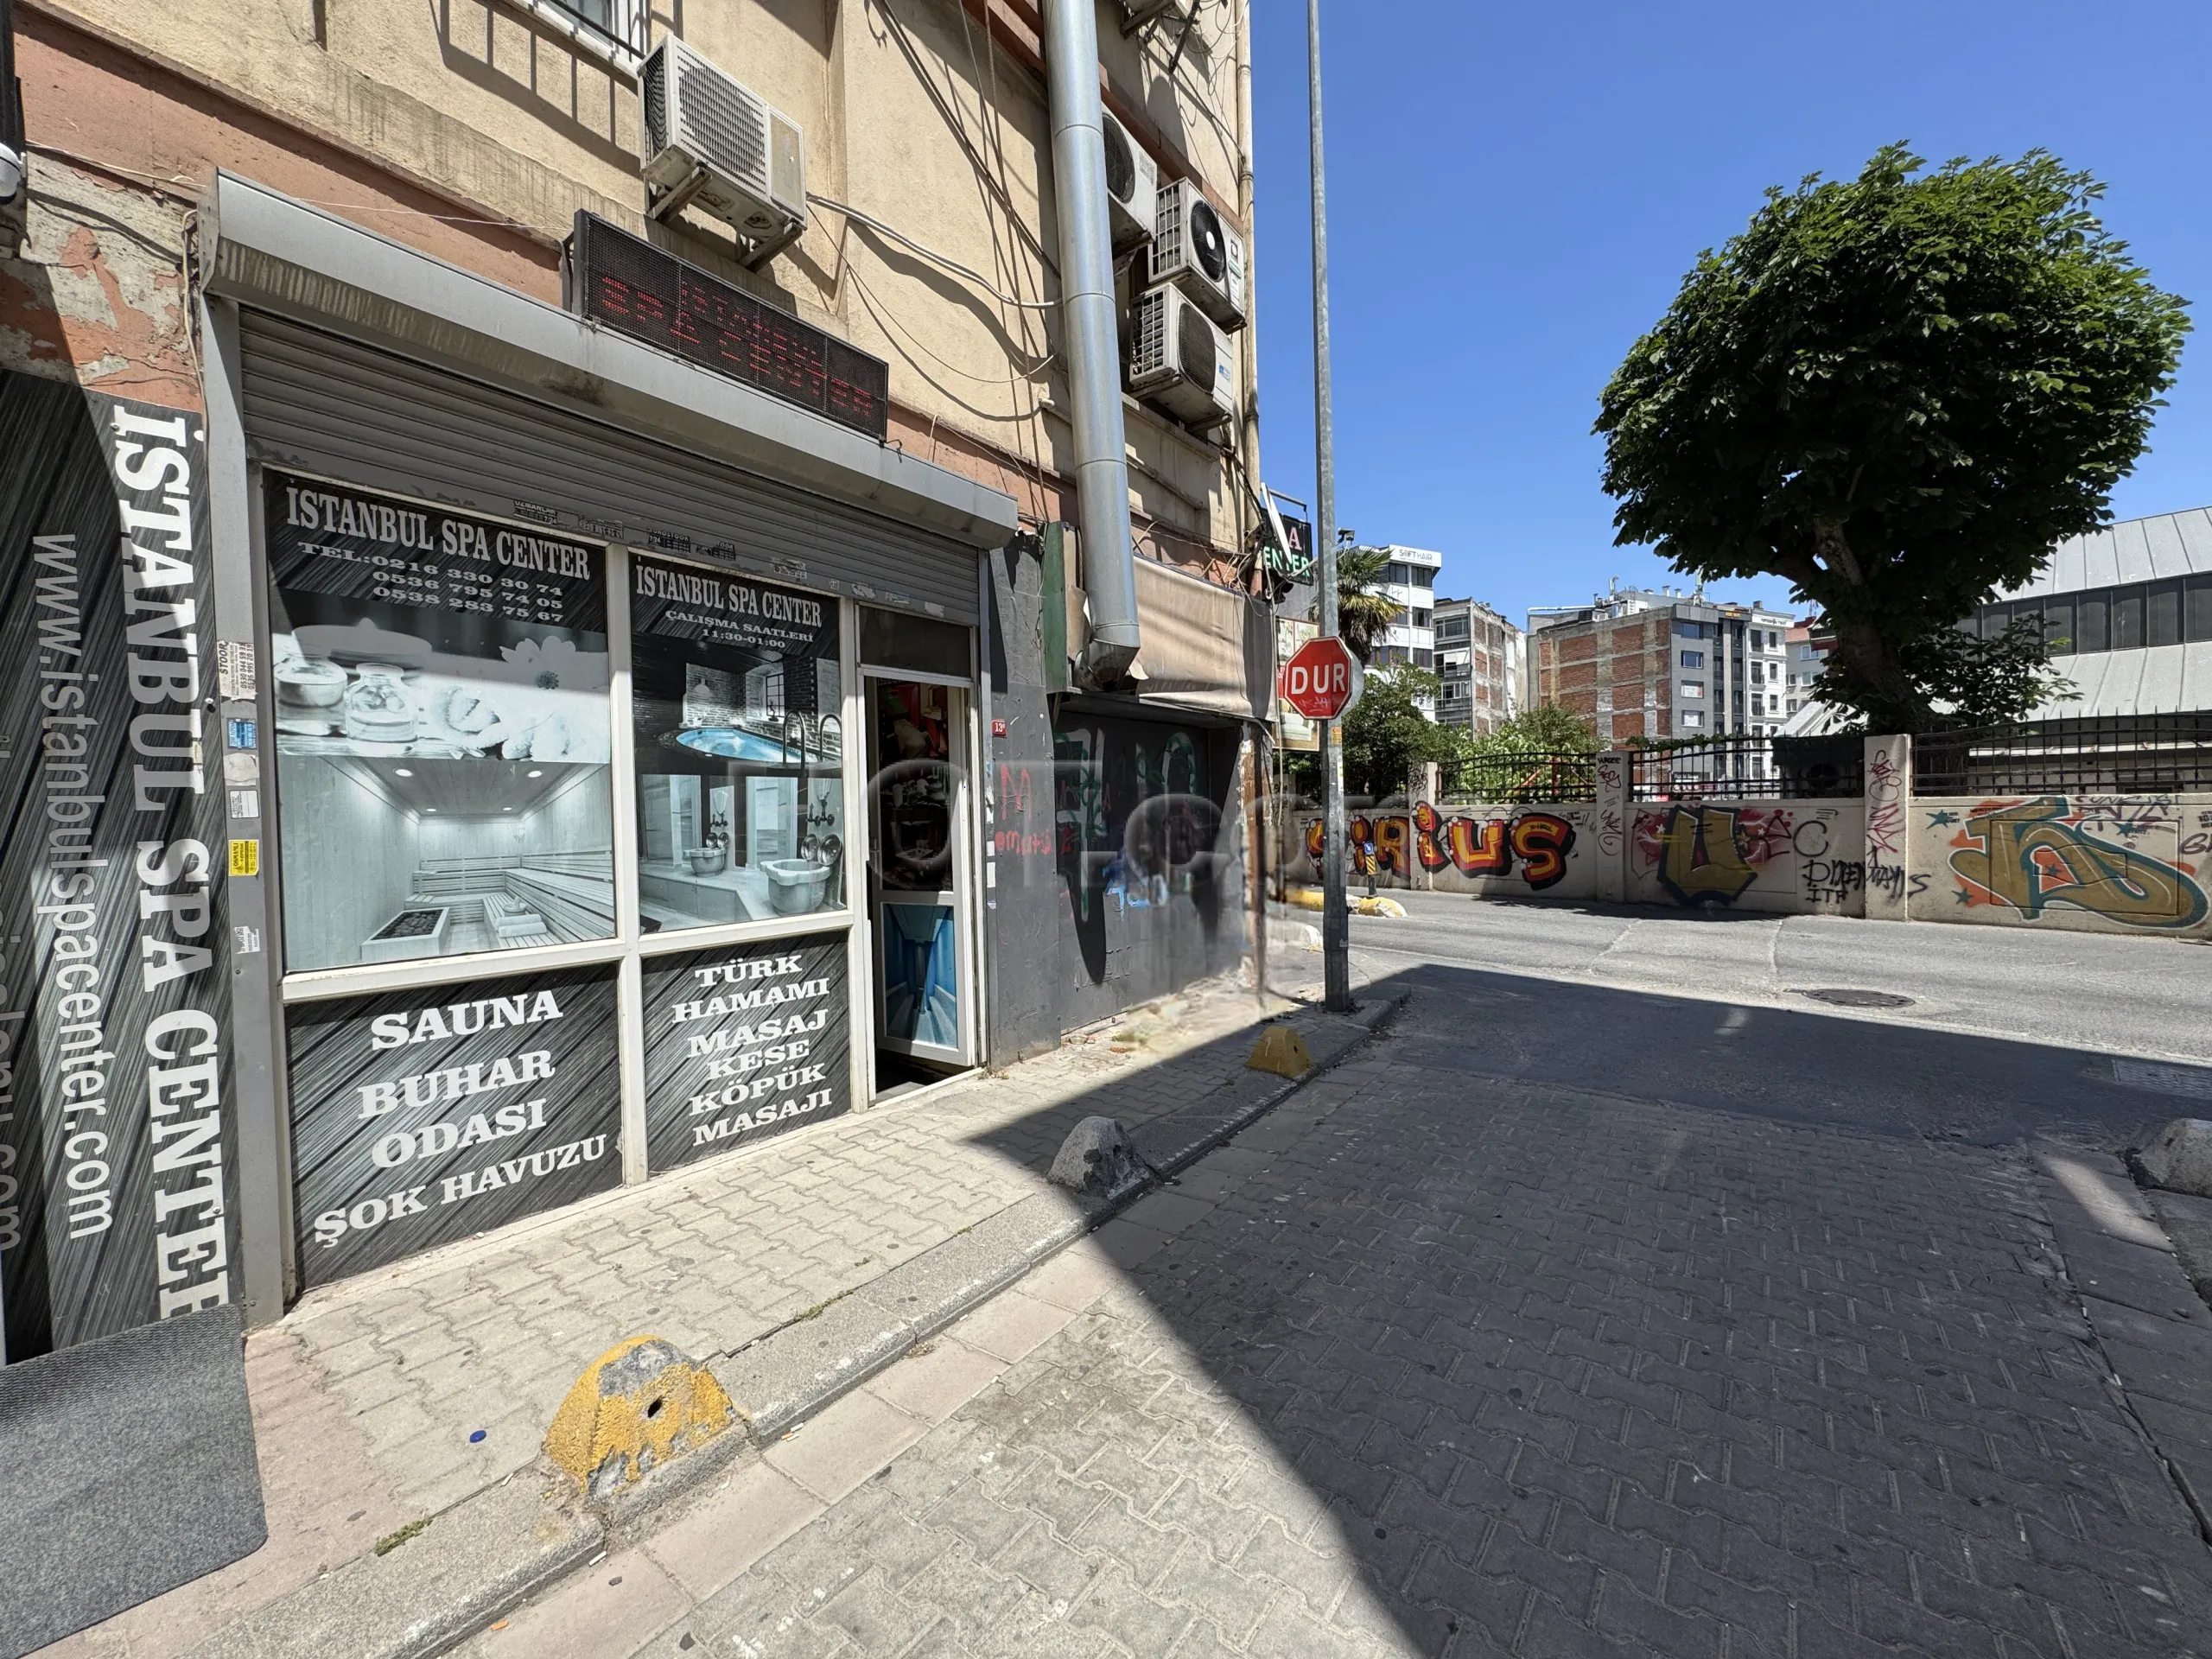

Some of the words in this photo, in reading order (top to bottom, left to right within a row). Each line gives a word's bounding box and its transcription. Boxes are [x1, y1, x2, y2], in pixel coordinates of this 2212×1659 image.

[298, 542, 438, 575] TEL:0216
[448, 569, 493, 583] 330
[500, 578, 529, 590] 30
[537, 584, 563, 596] 74
[442, 519, 491, 562] SPA
[496, 531, 590, 580] CENTER
[372, 571, 440, 589] 0536
[449, 584, 493, 598] 795
[502, 592, 530, 605] 74
[537, 598, 563, 609] 05
[372, 587, 440, 605] 0538
[449, 598, 493, 613] 283
[502, 606, 530, 618] 75
[537, 611, 563, 623] 67
[728, 584, 759, 616] SPA
[763, 591, 821, 627] CENTER
[665, 609, 738, 629] ÇALIŞMA
[743, 623, 814, 642] SAATLERİ
[702, 628, 785, 648] 11:30-01:00
[1291, 663, 1345, 695] DUR
[33, 534, 115, 1240] www.istanbulspacenter.com
[137, 838, 212, 992] SPA
[694, 955, 803, 988] TÜRK
[372, 989, 563, 1051] SAUNA
[672, 977, 830, 1024] HAMAMI
[686, 1009, 829, 1058] MASAJ
[357, 1049, 556, 1119] BUHAR
[707, 1039, 810, 1080] KESE
[689, 1063, 826, 1116] KÖPÜK
[372, 1098, 547, 1168] ODASI
[693, 1088, 832, 1147] MASAJI
[314, 1185, 427, 1249] ŞOK
[440, 1135, 607, 1205] HAVUZU
